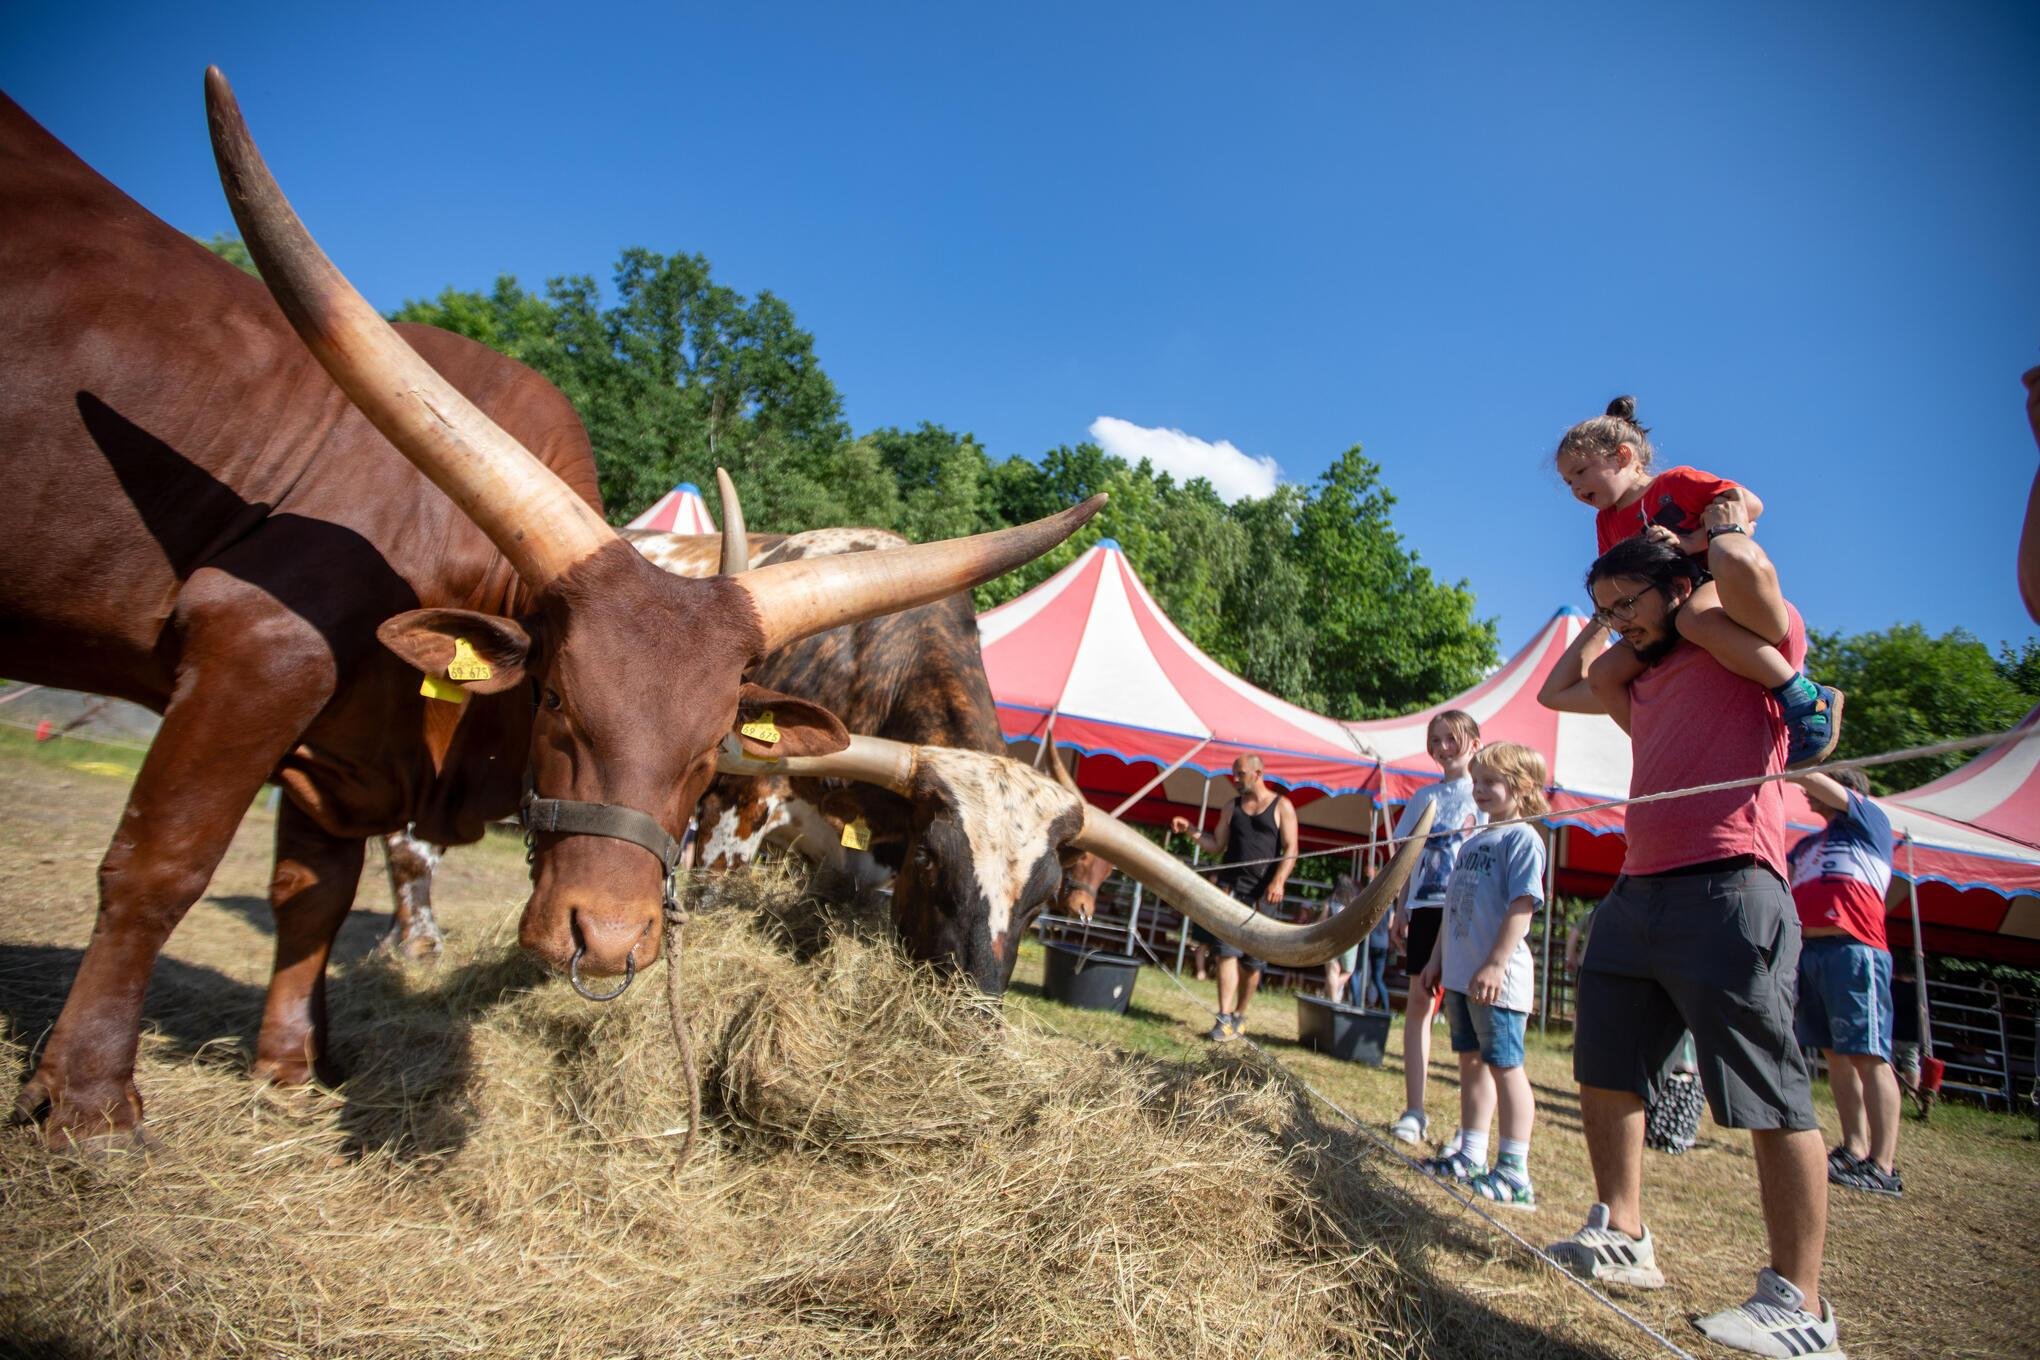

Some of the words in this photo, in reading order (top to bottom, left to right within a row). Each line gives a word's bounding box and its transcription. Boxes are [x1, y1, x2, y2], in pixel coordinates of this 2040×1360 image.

[452, 667, 463, 678] 69
[470, 667, 489, 678] 675
[743, 726, 756, 735] 69
[760, 731, 778, 741] 675
